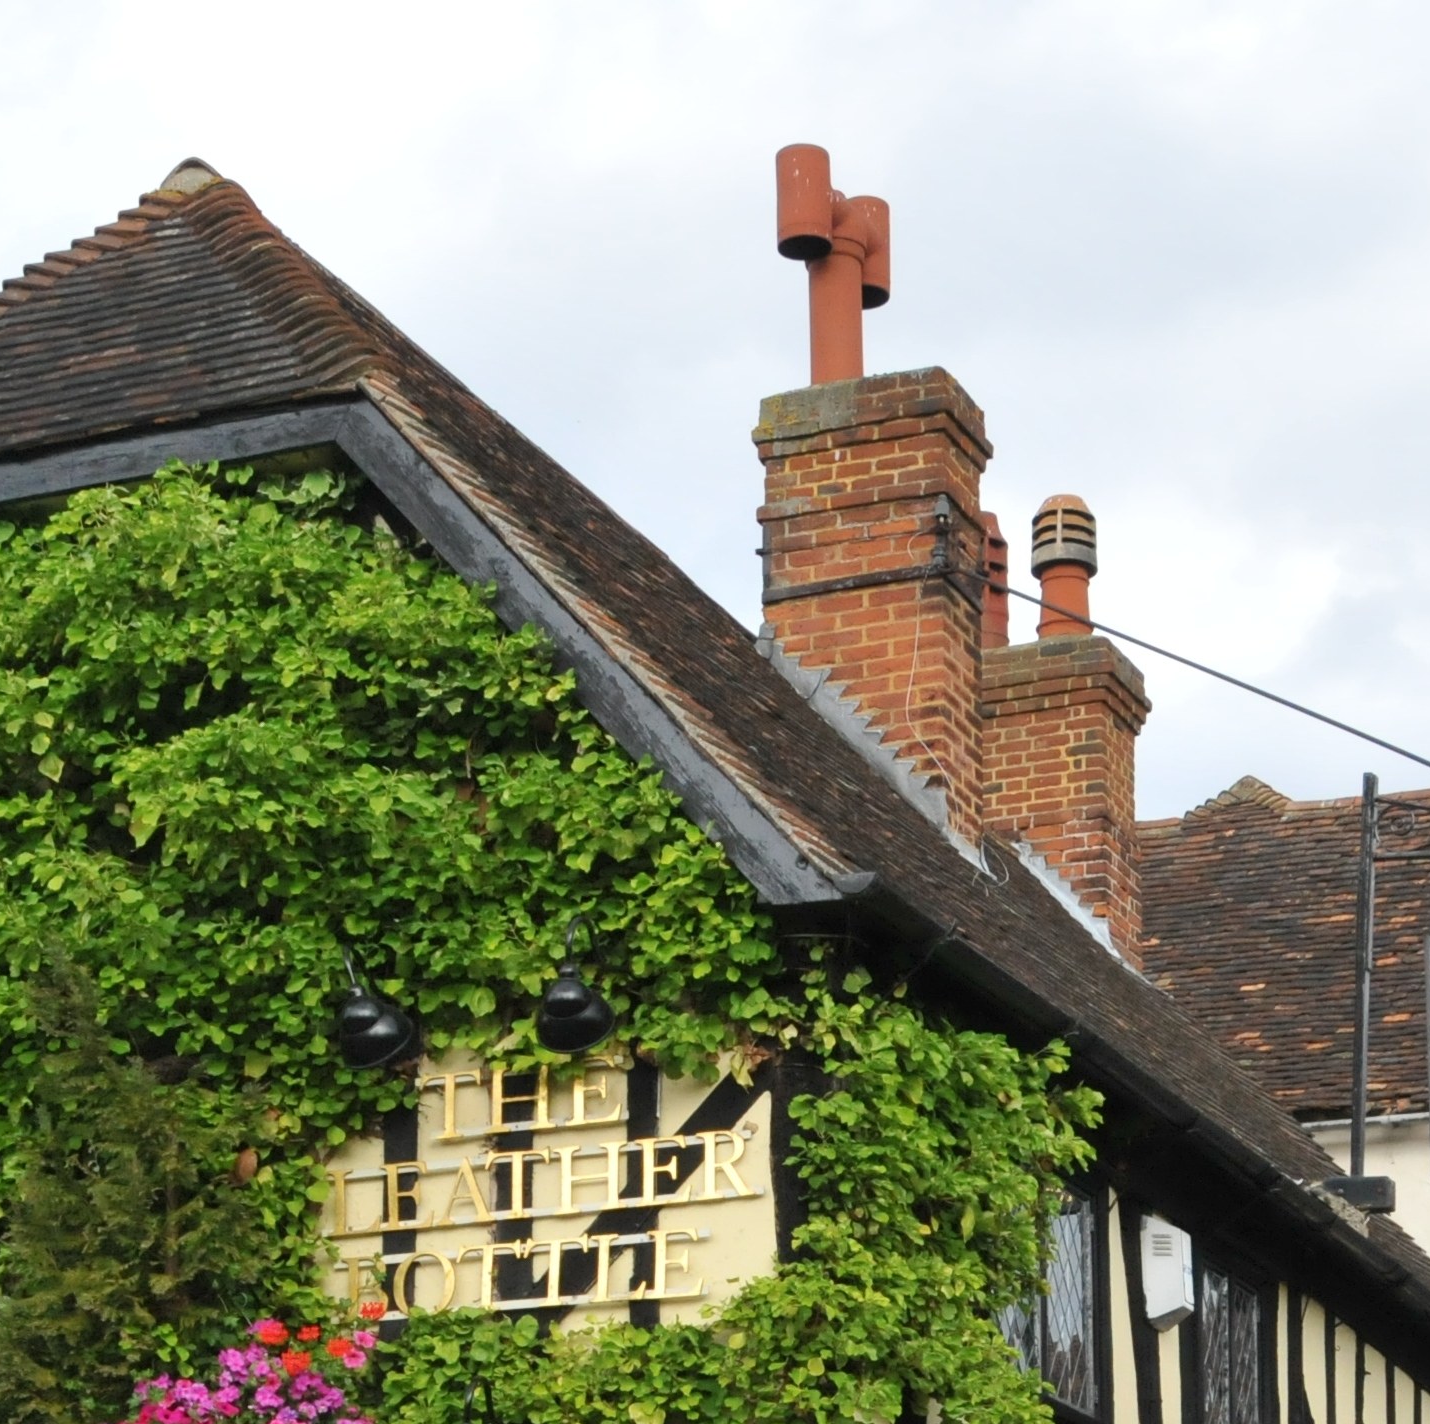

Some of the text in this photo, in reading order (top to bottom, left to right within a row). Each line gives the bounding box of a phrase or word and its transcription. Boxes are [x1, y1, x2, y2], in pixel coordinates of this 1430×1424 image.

[421, 1055, 624, 1140] THE
[328, 1130, 758, 1237] LEATHER
[342, 1227, 704, 1320] BOTTLE
